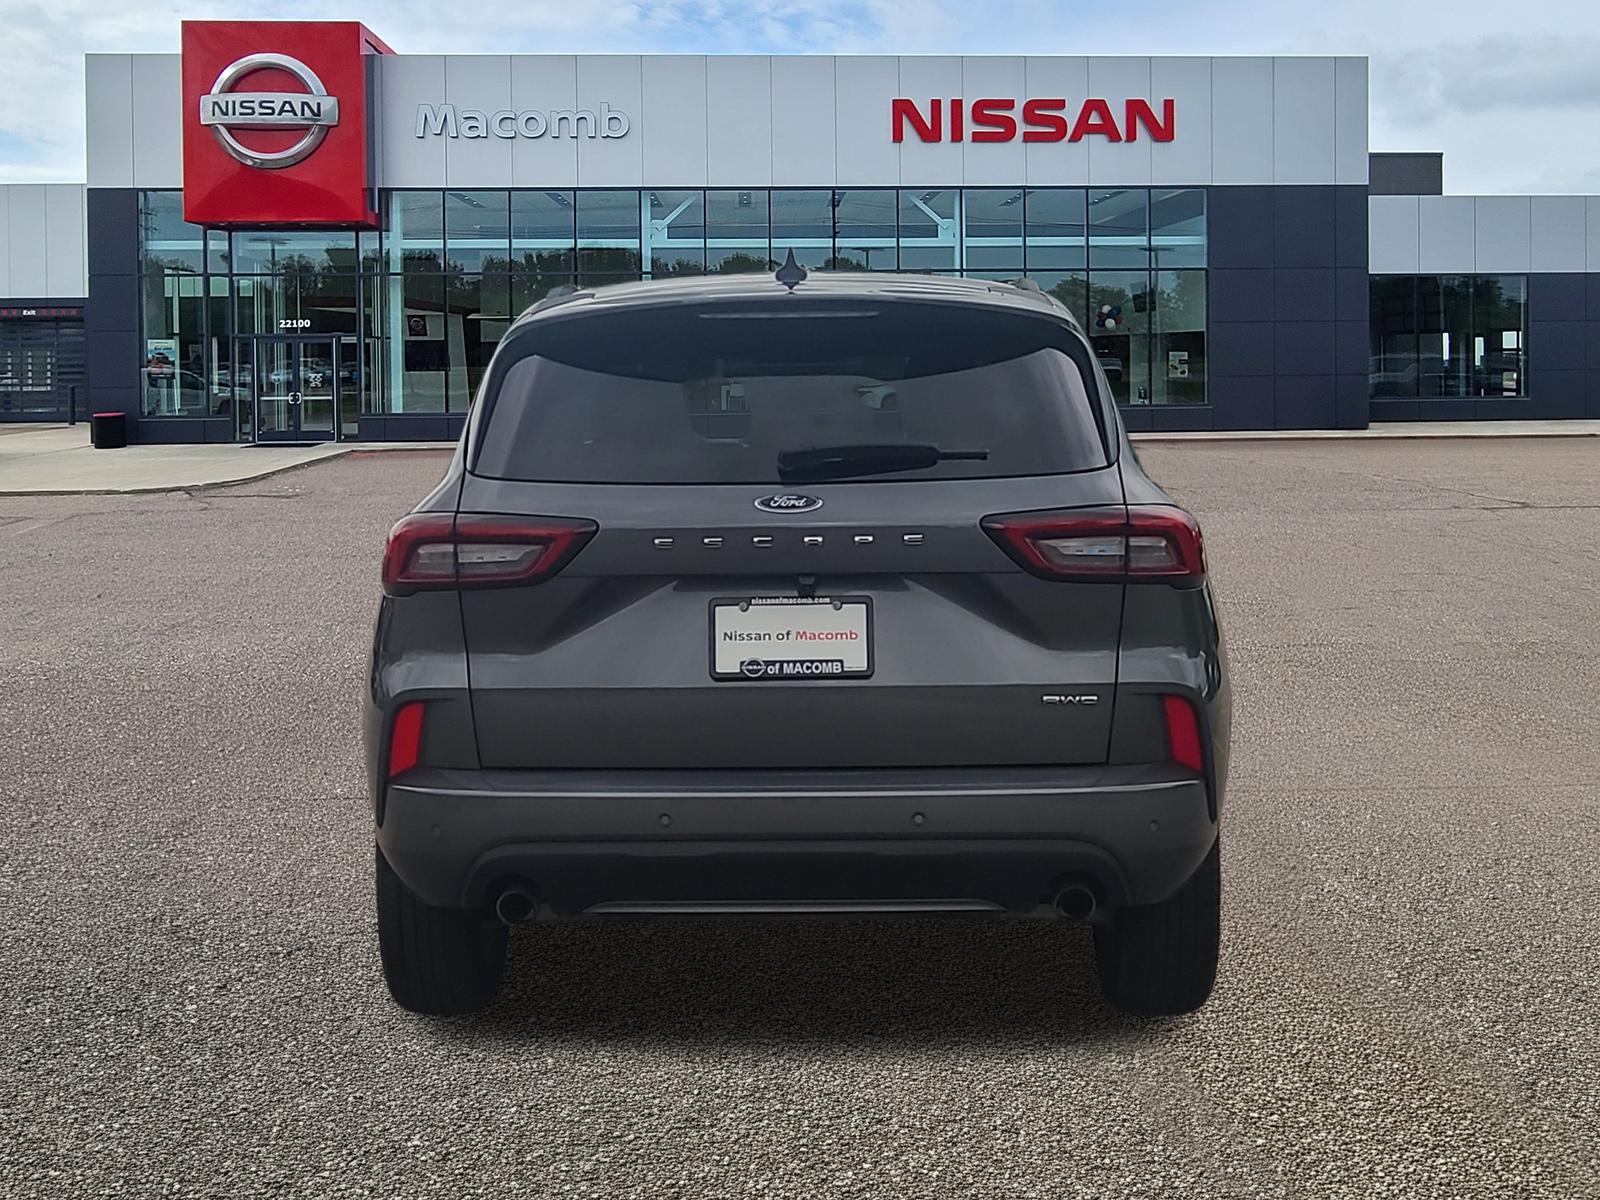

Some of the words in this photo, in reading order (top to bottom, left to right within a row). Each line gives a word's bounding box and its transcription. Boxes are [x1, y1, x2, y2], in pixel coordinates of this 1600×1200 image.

[211, 99, 321, 118] NISSAN
[415, 102, 630, 139] Macomb
[892, 98, 1175, 143] NISSAN
[22, 305, 36, 315] Exit
[279, 319, 311, 328] 22100
[770, 495, 807, 508] Ford
[653, 534, 924, 548] ESCAPE
[722, 630, 772, 642] Nissan
[775, 630, 792, 641] of
[795, 630, 858, 641] Macomb
[767, 663, 780, 674] of
[783, 661, 842, 674] MACOMB
